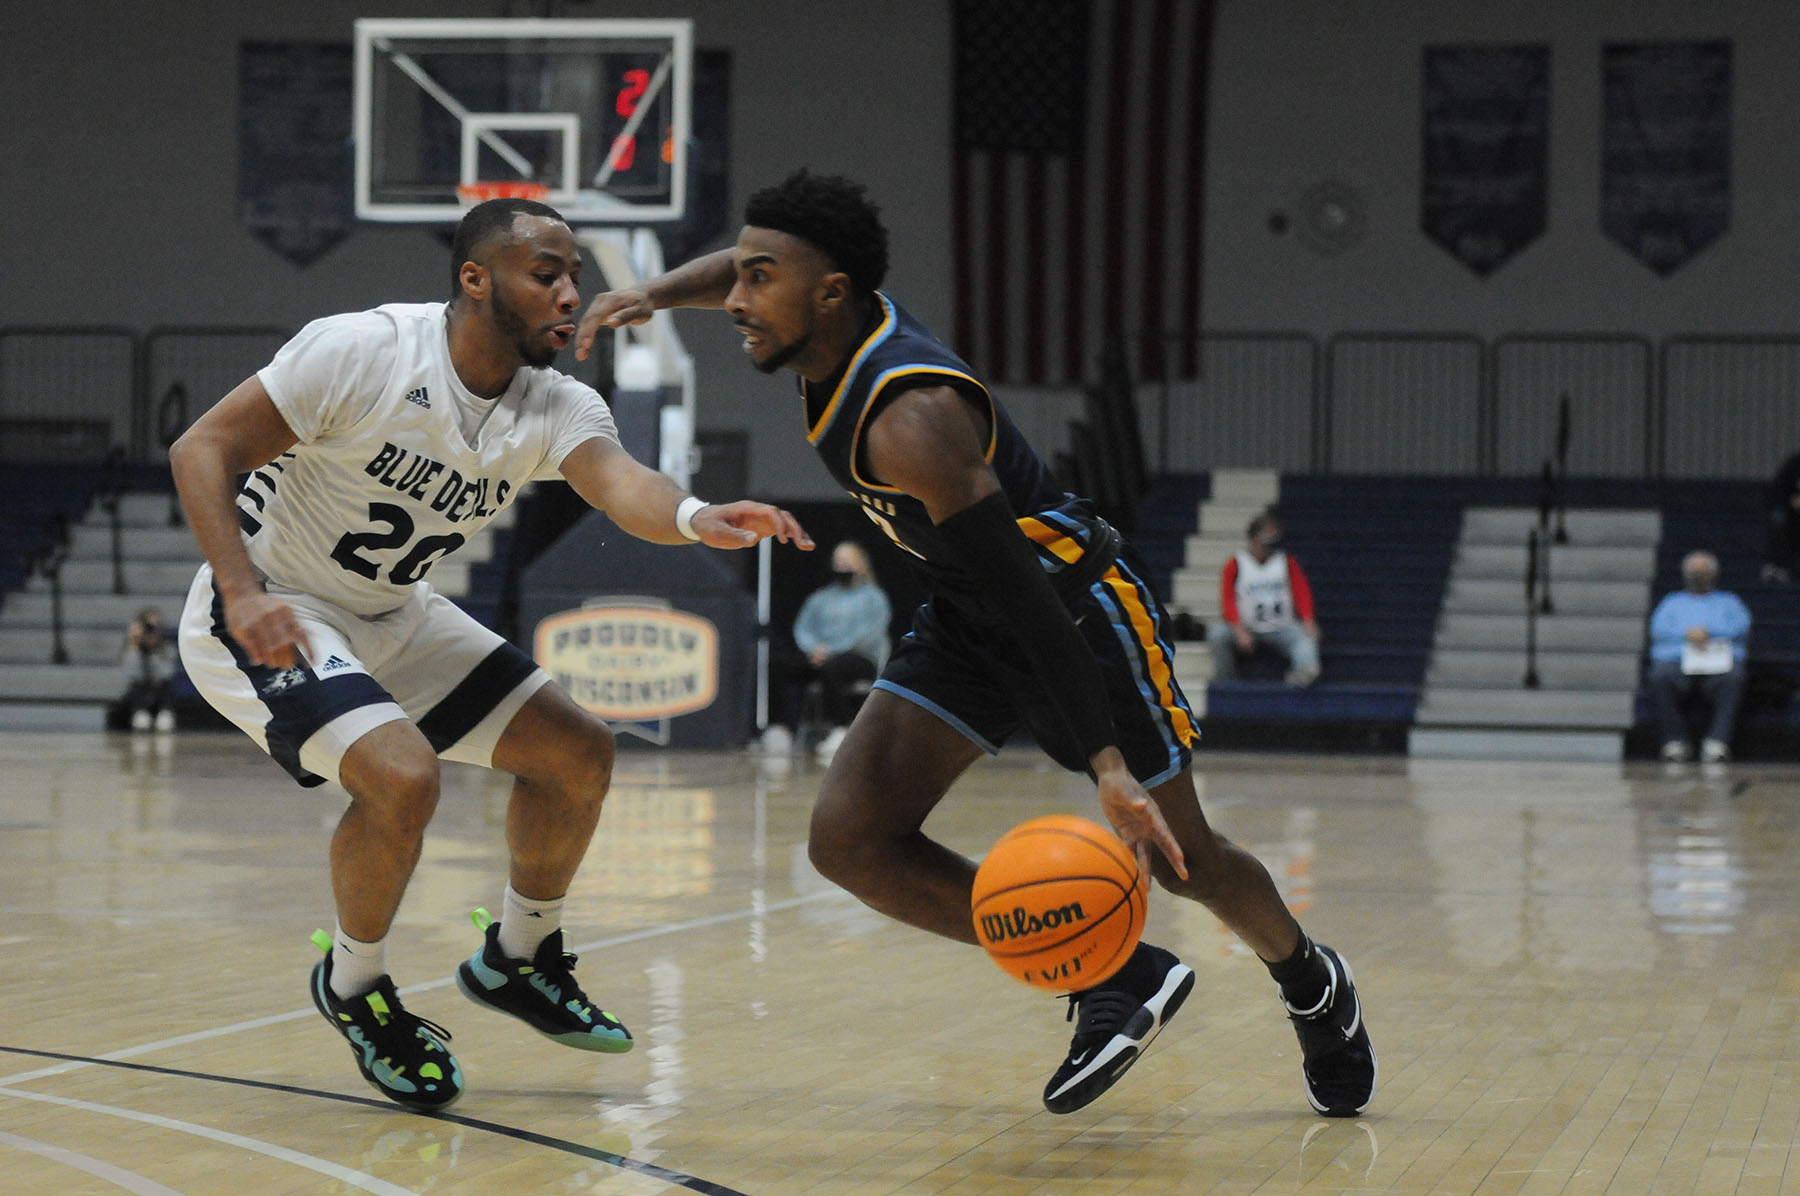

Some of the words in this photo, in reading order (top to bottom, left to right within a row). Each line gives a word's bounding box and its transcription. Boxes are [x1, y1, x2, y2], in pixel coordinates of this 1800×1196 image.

[364, 441, 445, 501] BLUE
[330, 502, 465, 585] 20
[554, 622, 698, 654] PROUDLY
[981, 902, 1087, 944] Wilson
